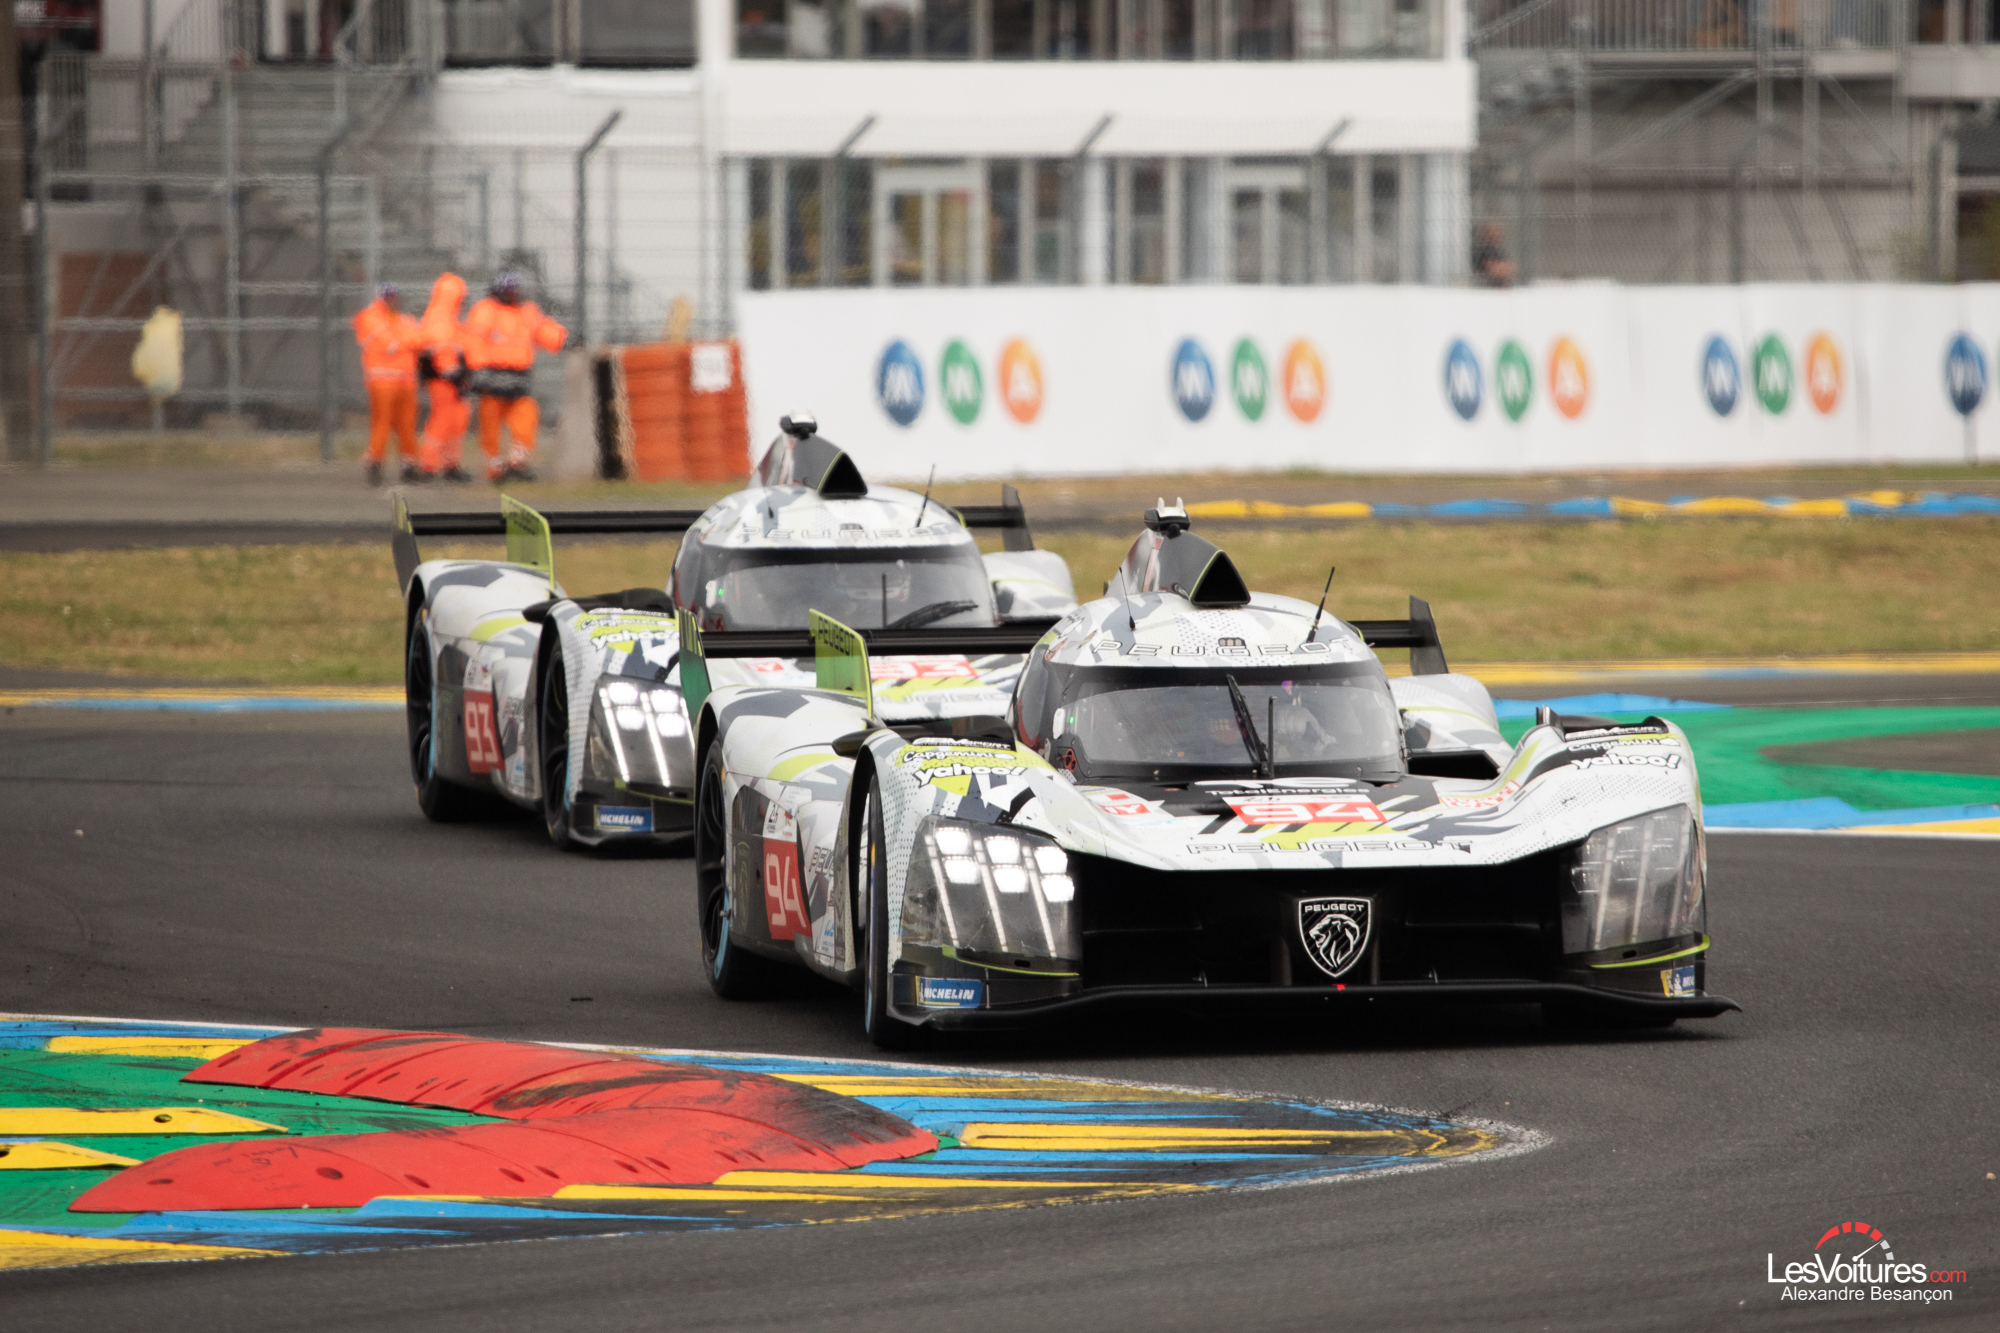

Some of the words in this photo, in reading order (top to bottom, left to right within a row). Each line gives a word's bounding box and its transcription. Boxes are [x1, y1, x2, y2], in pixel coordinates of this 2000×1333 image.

[818, 615, 855, 658] PEUGEOT
[1093, 637, 1356, 656] PEUGEOT
[465, 700, 499, 763] 93
[1567, 738, 1660, 751] Capgemini
[902, 751, 994, 763] Capgemini
[1571, 753, 1681, 770] yahoo!
[912, 762, 1028, 789] yahoo!
[1241, 803, 1380, 822] 94
[1186, 839, 1474, 854] PEUGEOT
[765, 853, 807, 928] 94
[1304, 903, 1365, 913] PEUGEOT
[923, 987, 975, 1000] MICHELIN
